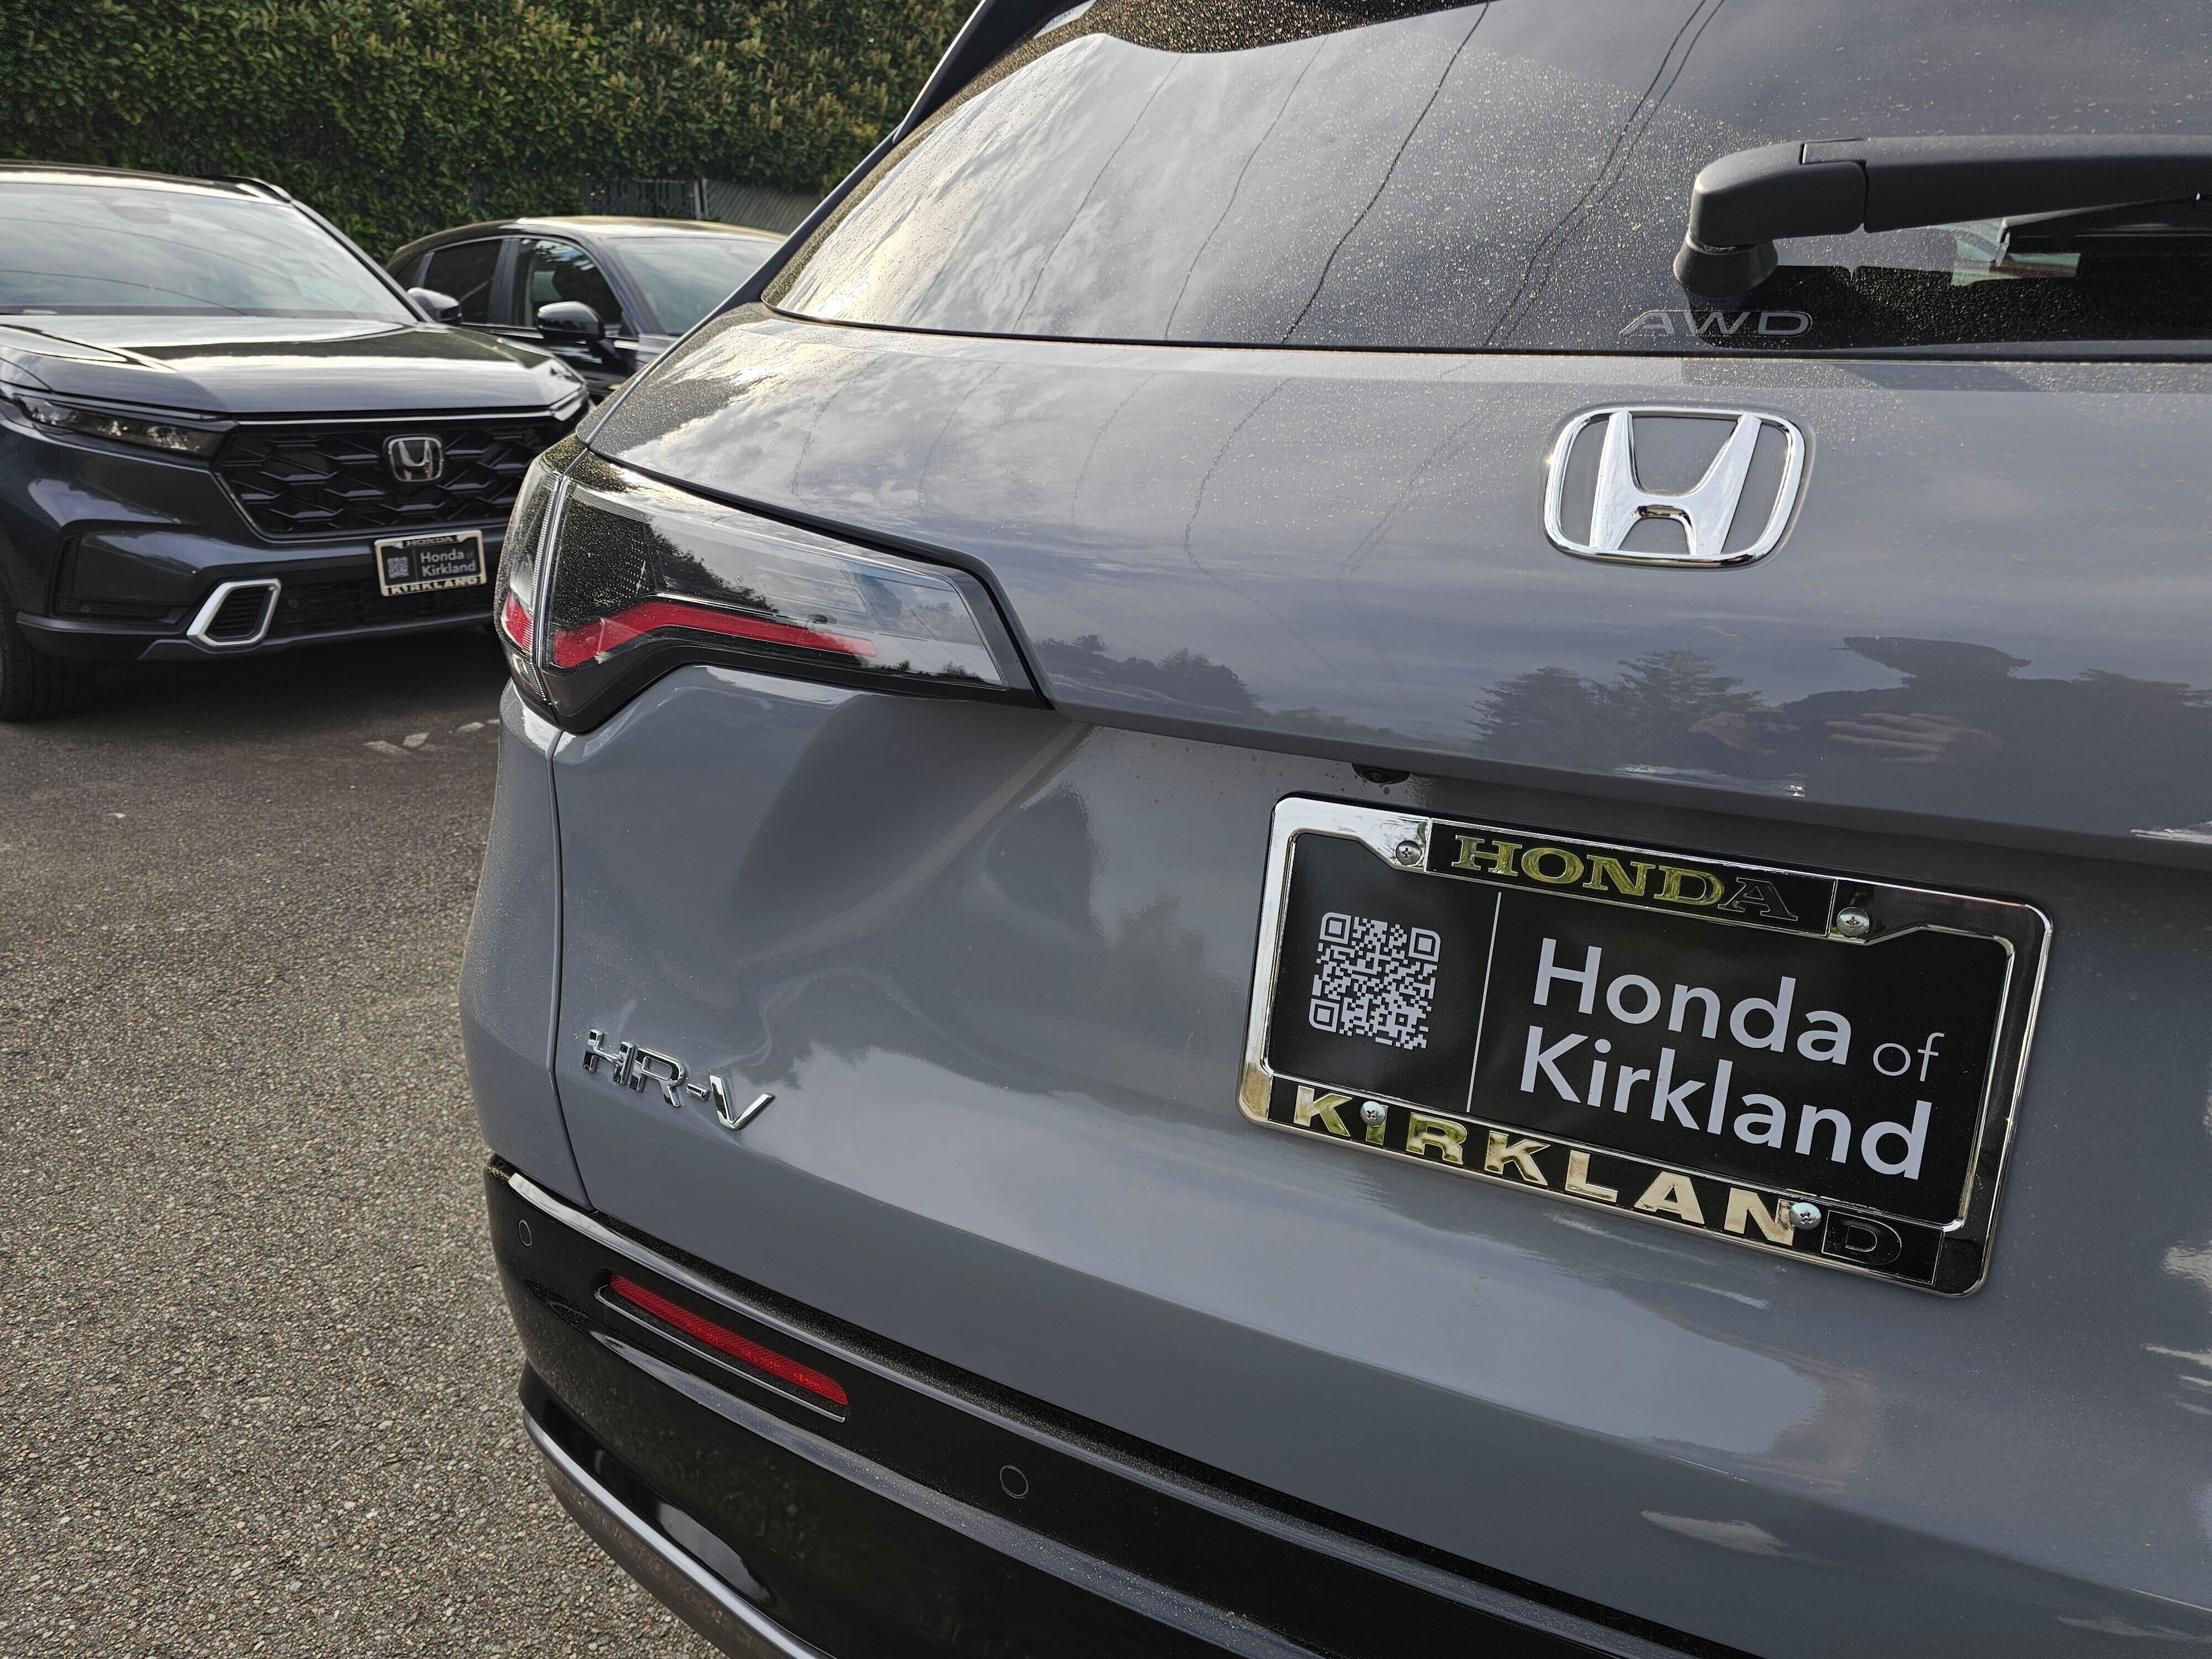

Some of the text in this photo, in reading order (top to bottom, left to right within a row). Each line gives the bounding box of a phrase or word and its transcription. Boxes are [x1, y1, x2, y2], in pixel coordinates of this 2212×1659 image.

[1618, 310, 1813, 337] AWD
[420, 548, 465, 564] Honda
[421, 559, 476, 577] Kirkland
[1451, 834, 1798, 921] HONDA
[1532, 937, 1945, 1082] Honda of
[582, 1029, 776, 1131] HR-V
[1520, 1025, 1932, 1180] Kirkland
[1293, 1085, 1902, 1265] KIRKLAND
